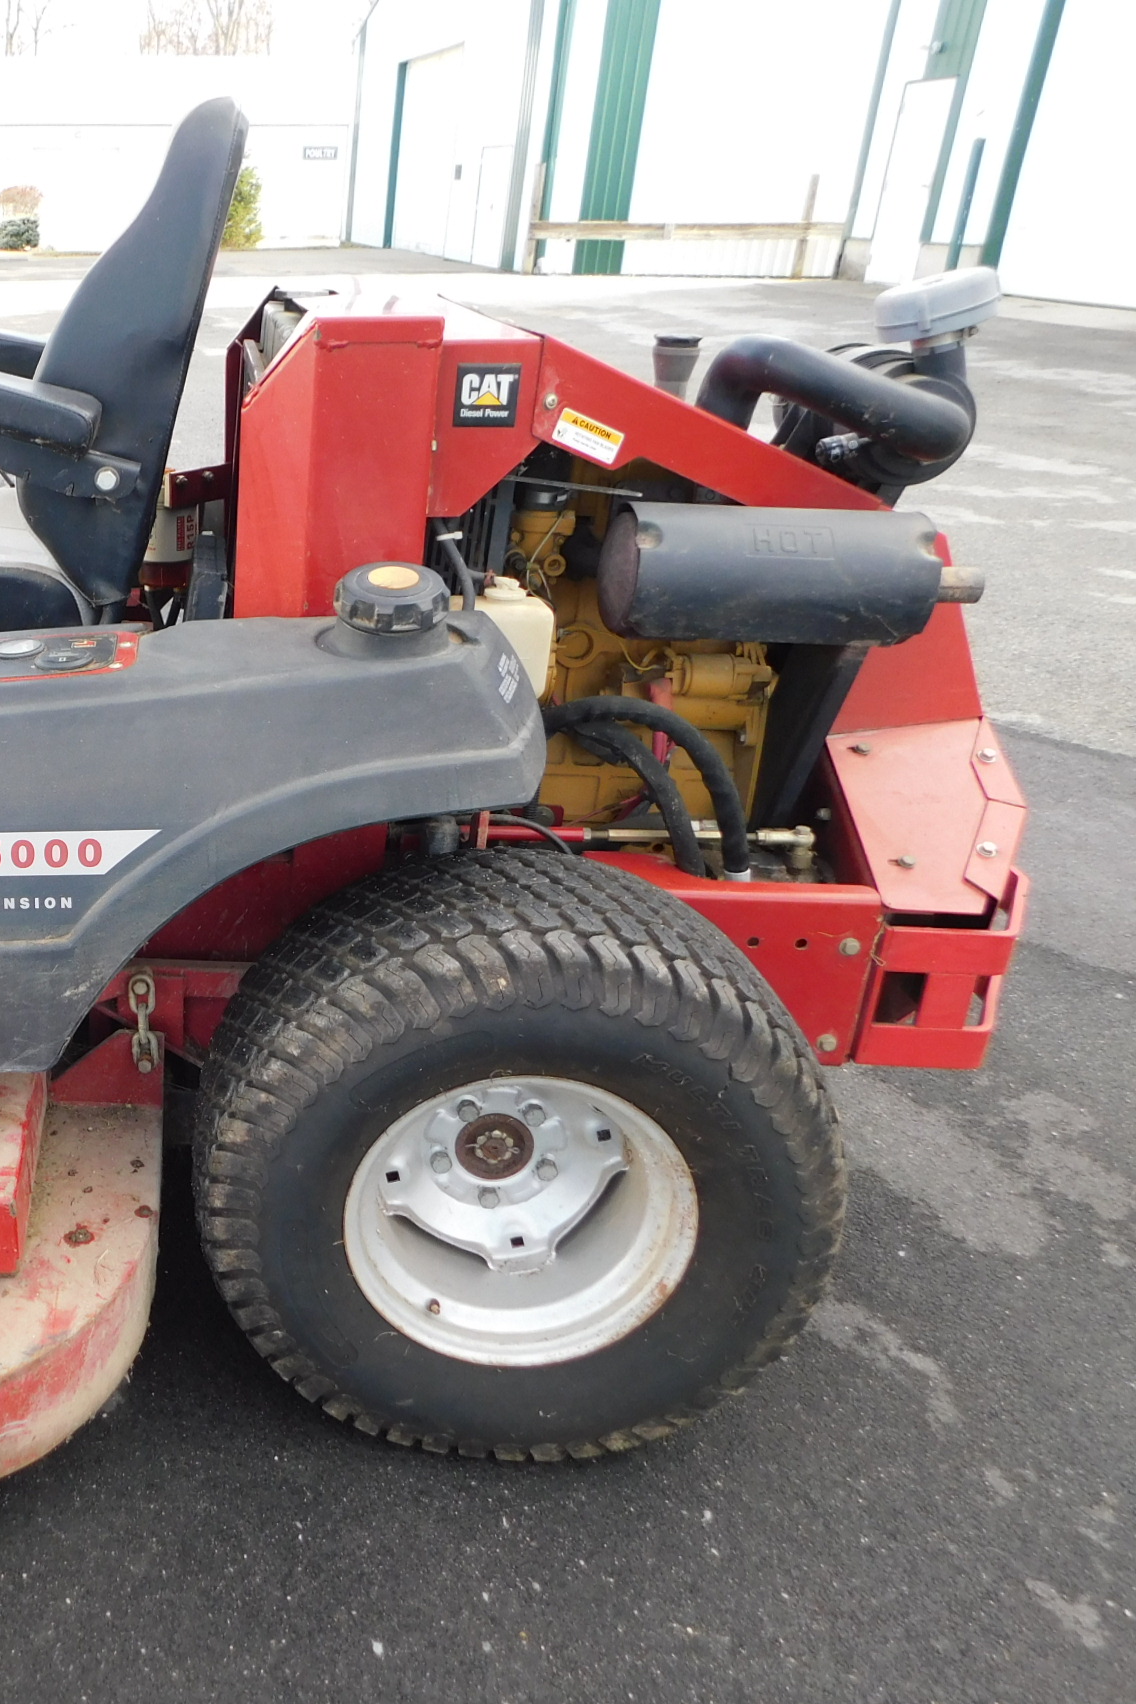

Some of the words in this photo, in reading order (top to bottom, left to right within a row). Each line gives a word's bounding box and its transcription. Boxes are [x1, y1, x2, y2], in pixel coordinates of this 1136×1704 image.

[461, 373, 514, 405] CAT
[460, 408, 484, 417] Diesel
[484, 408, 509, 417] Power
[579, 419, 612, 440] CAUTION
[752, 527, 823, 554] HOT
[630, 1053, 742, 1130] MULTI
